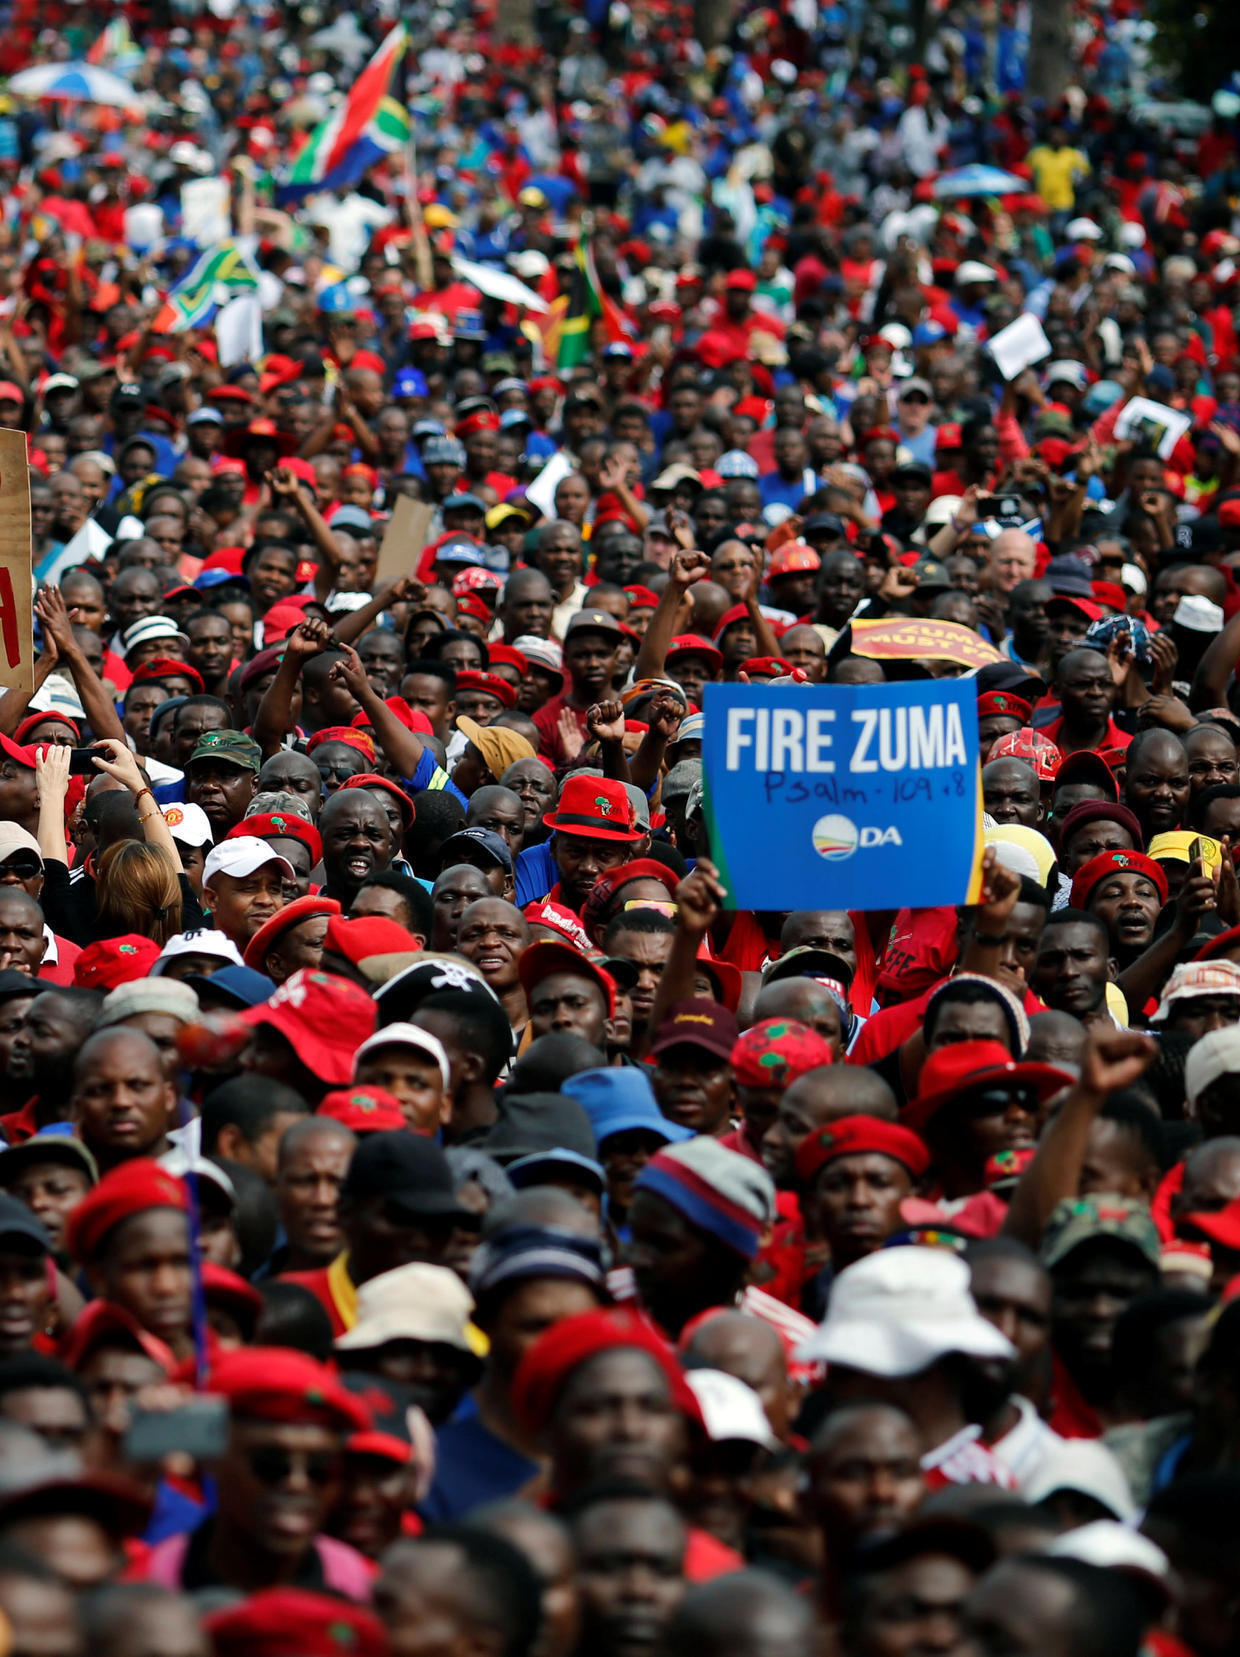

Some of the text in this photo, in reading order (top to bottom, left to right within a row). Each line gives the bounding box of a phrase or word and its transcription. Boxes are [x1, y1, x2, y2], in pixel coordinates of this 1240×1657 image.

[863, 634, 954, 649] MUST
[726, 703, 967, 772] FIRE ZUMA
[764, 771, 868, 805] Psalm
[893, 777, 932, 804] 109
[860, 825, 903, 847] DA
